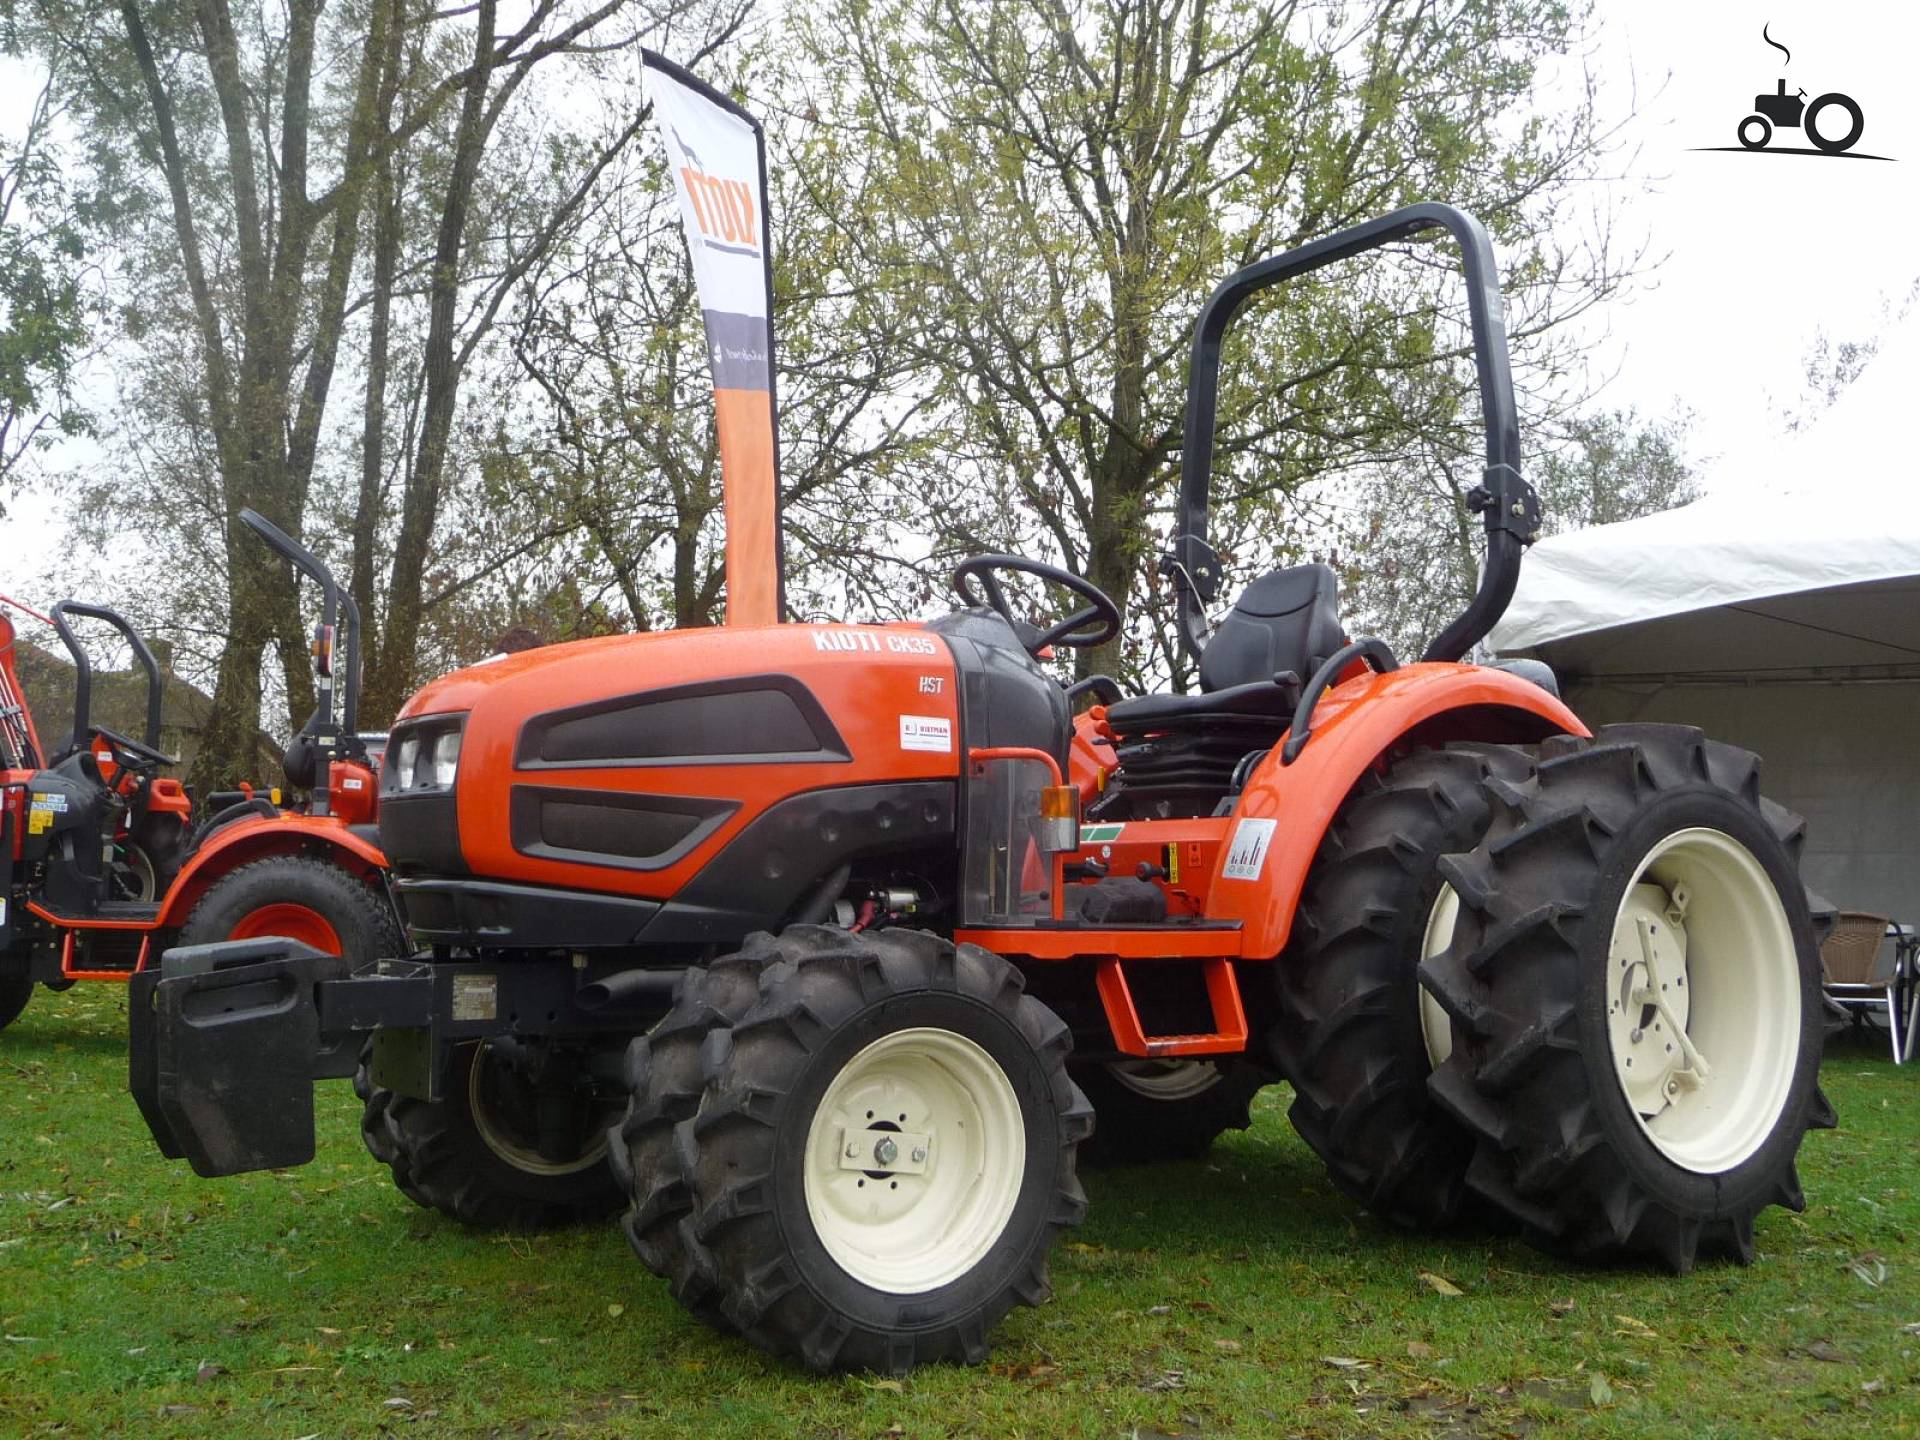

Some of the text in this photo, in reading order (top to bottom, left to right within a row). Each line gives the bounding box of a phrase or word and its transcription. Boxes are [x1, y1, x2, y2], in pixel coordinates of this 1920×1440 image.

[812, 631, 936, 655] KIOTI CK35
[919, 676, 944, 694] HST
